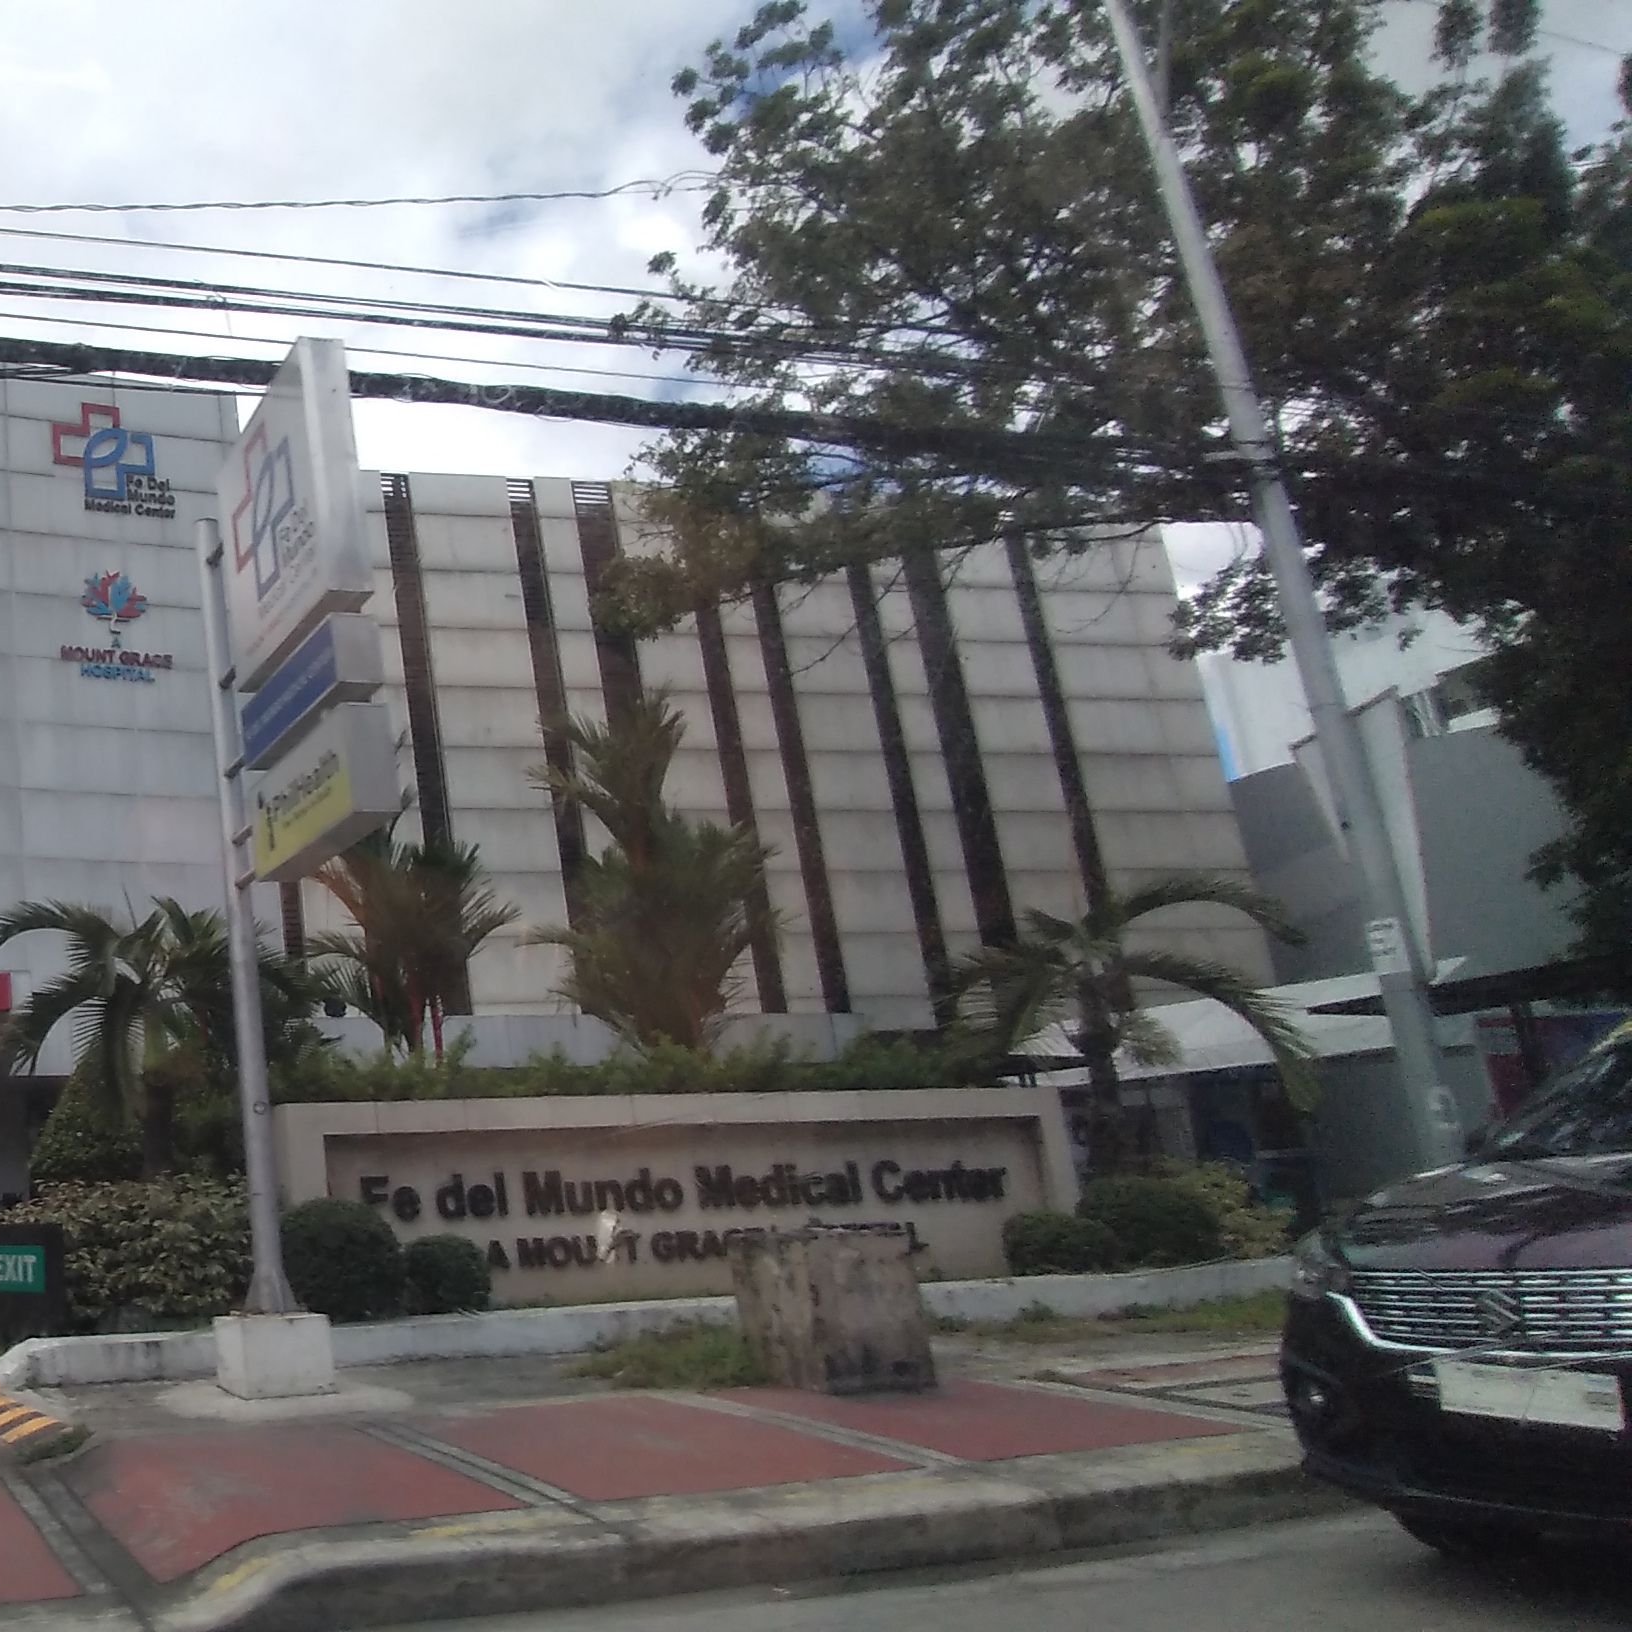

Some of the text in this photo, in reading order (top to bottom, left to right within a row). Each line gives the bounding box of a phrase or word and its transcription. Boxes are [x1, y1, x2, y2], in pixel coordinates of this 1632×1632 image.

[126, 473, 170, 491] Fe Del
[127, 489, 176, 506] Mundo
[84, 498, 176, 518] Medical Center
[60, 645, 173, 670] MOUNT GRACE
[81, 663, 156, 683] HOSPITAL
[360, 1159, 1008, 1222] Fe del Mundo Medical Center
[488, 1239, 512, 1269] A
[516, 1229, 642, 1268] MOUT
